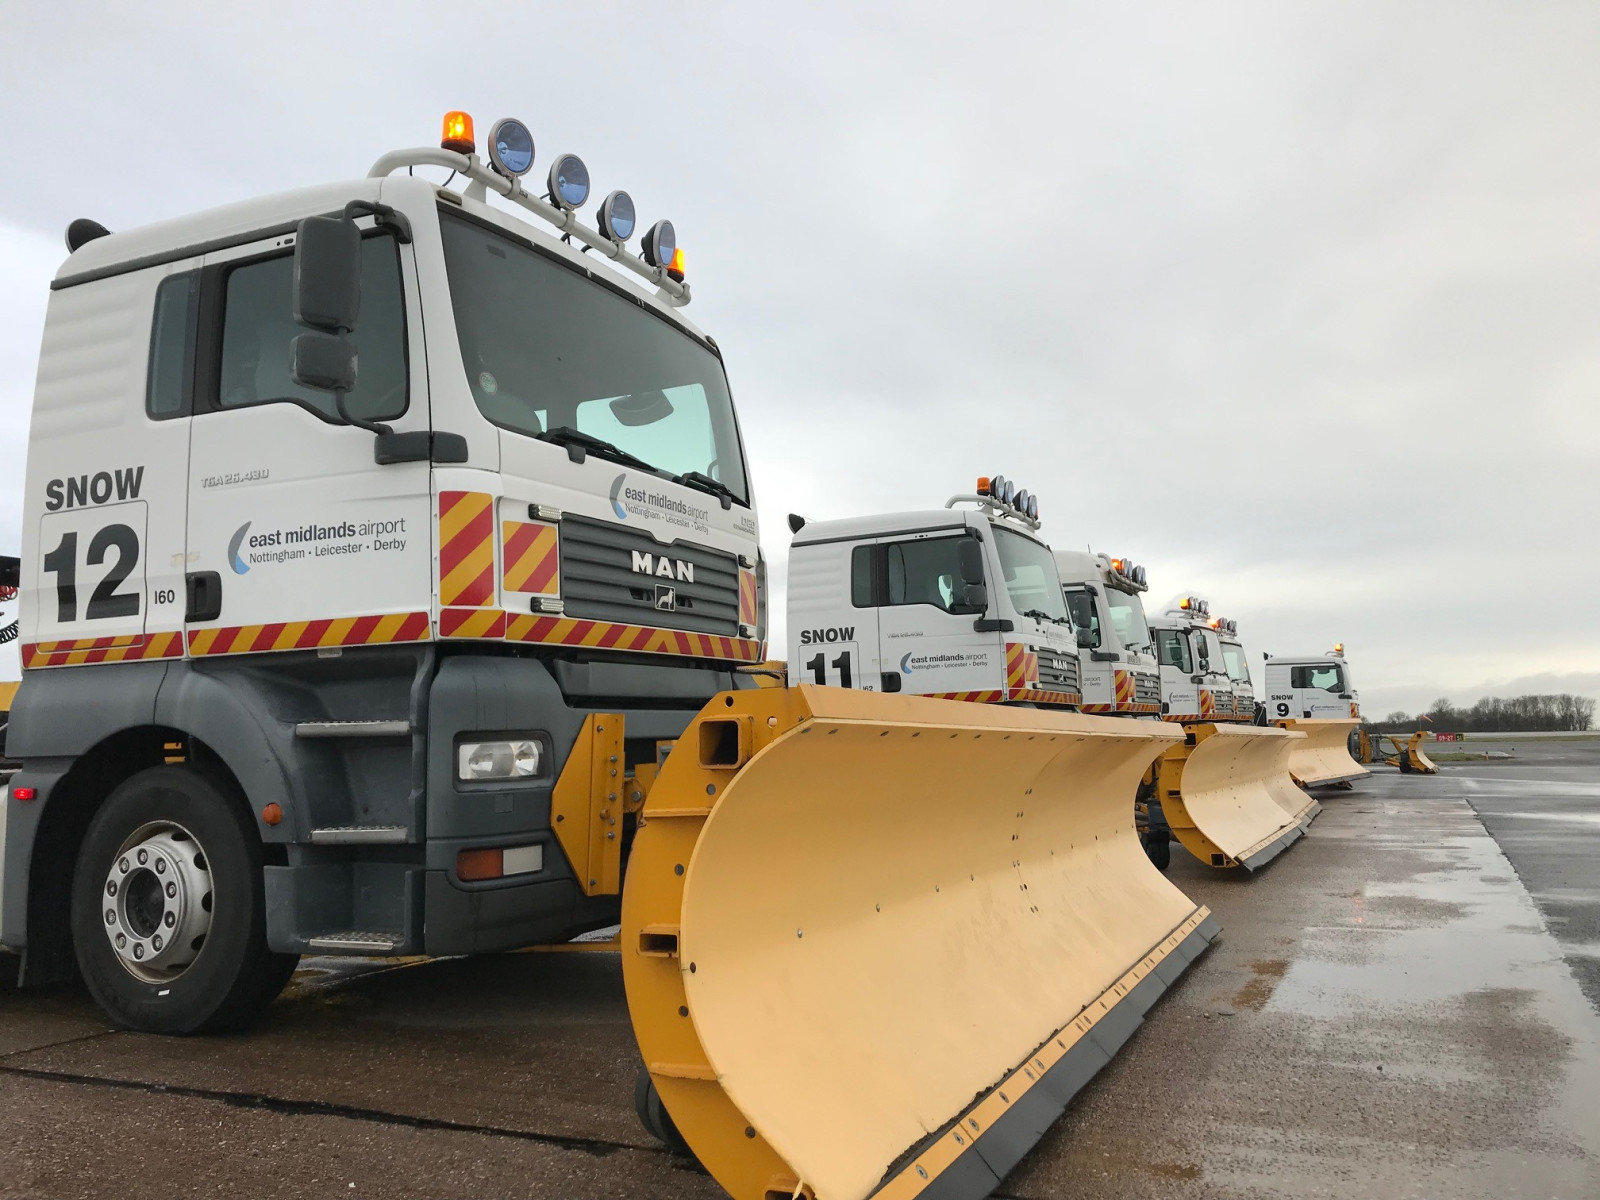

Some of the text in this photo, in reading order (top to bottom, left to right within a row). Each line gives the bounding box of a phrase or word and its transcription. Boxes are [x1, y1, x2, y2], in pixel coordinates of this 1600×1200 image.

[45, 465, 145, 511] SNOW
[625, 487, 709, 522] east midlands airport
[625, 503, 661, 521] Nottingham
[249, 517, 406, 548] east midlands airport
[249, 538, 407, 564] Nottingham Leicester Derby
[44, 523, 140, 623] 12
[631, 550, 694, 583] MAN
[800, 626, 855, 644] SNOW
[806, 651, 852, 689] 11
[911, 653, 988, 664] east midlands airport
[1052, 658, 1068, 670] MAN
[1276, 702, 1290, 717] 9
